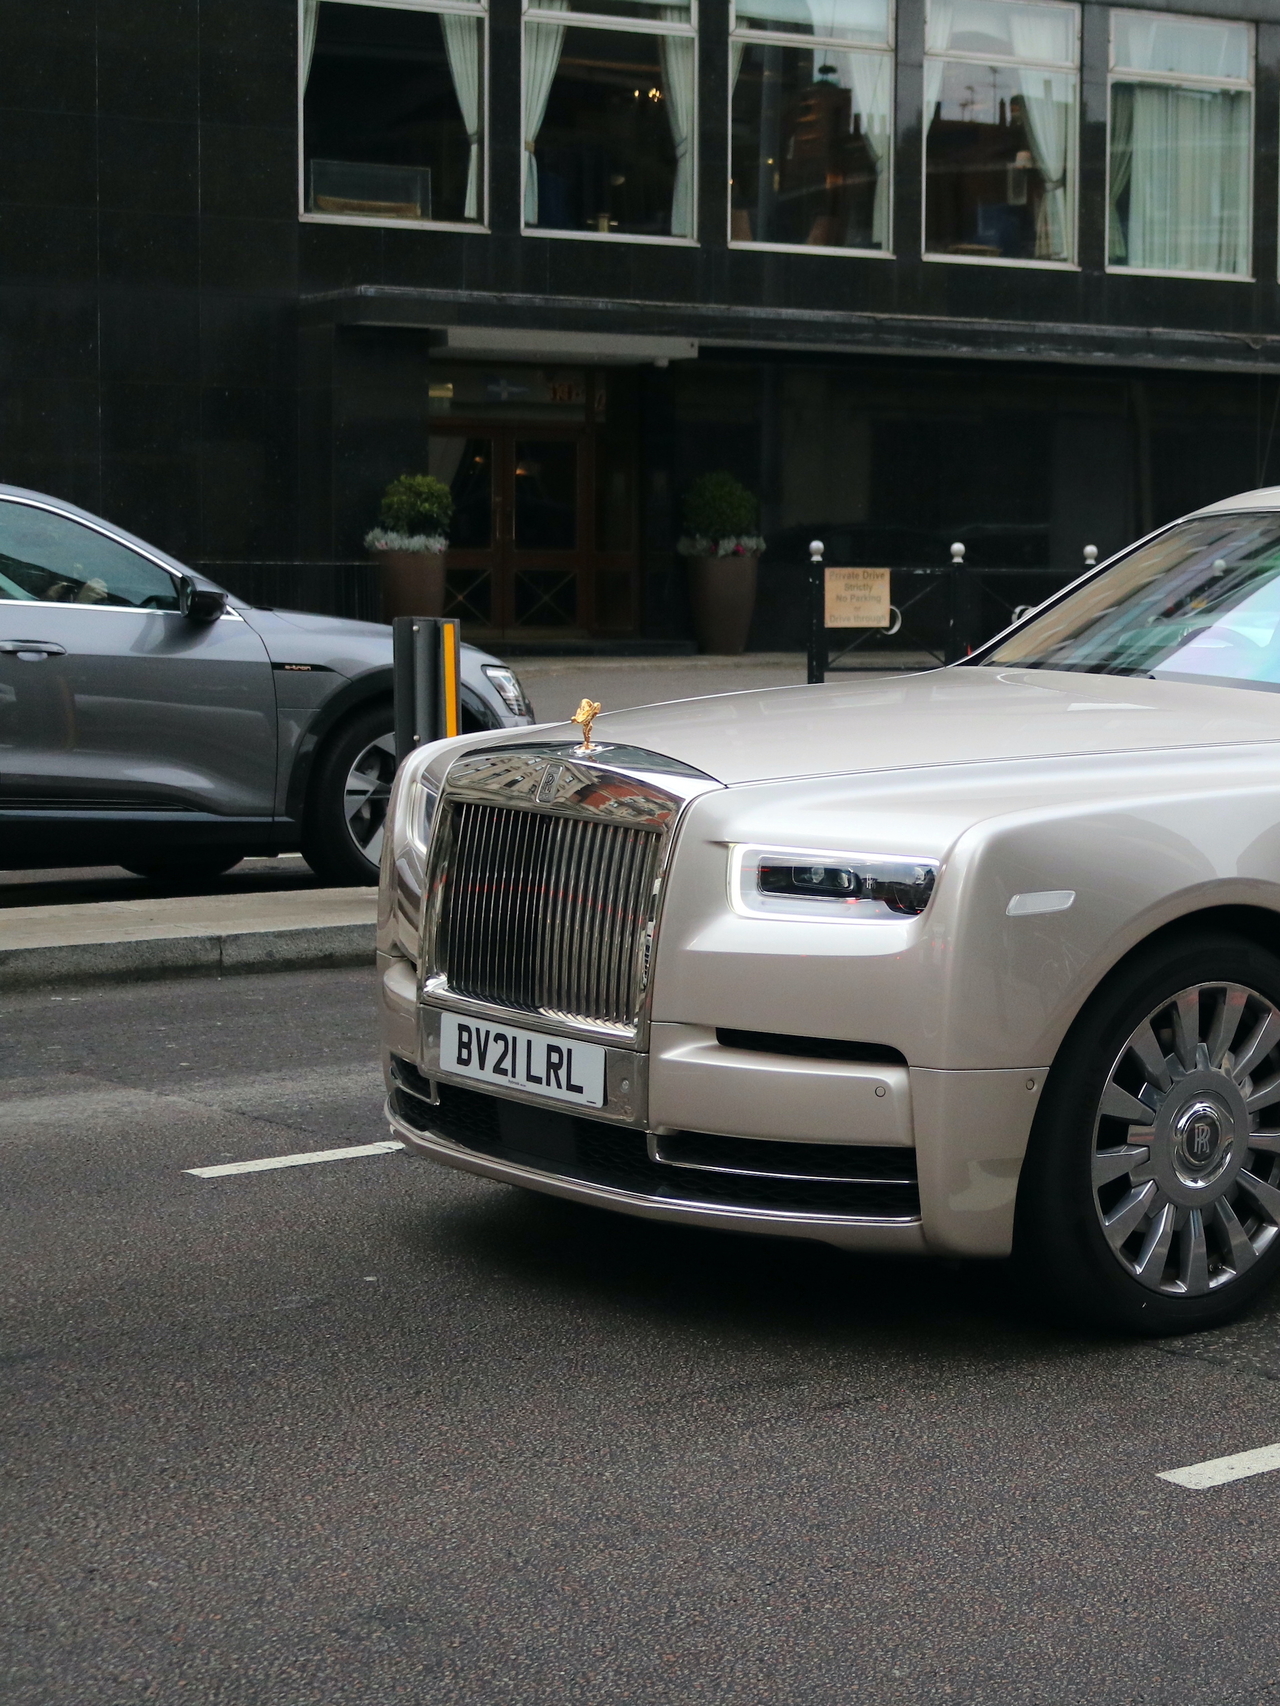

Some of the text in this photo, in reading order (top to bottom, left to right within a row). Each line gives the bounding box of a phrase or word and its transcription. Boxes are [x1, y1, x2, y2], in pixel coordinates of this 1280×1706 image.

[829, 570, 885, 580] Private Drive
[844, 583, 873, 593] Strictly
[836, 594, 882, 604] No Parking
[829, 615, 851, 624] Drive
[456, 1022, 584, 1095] BV21 LRL
